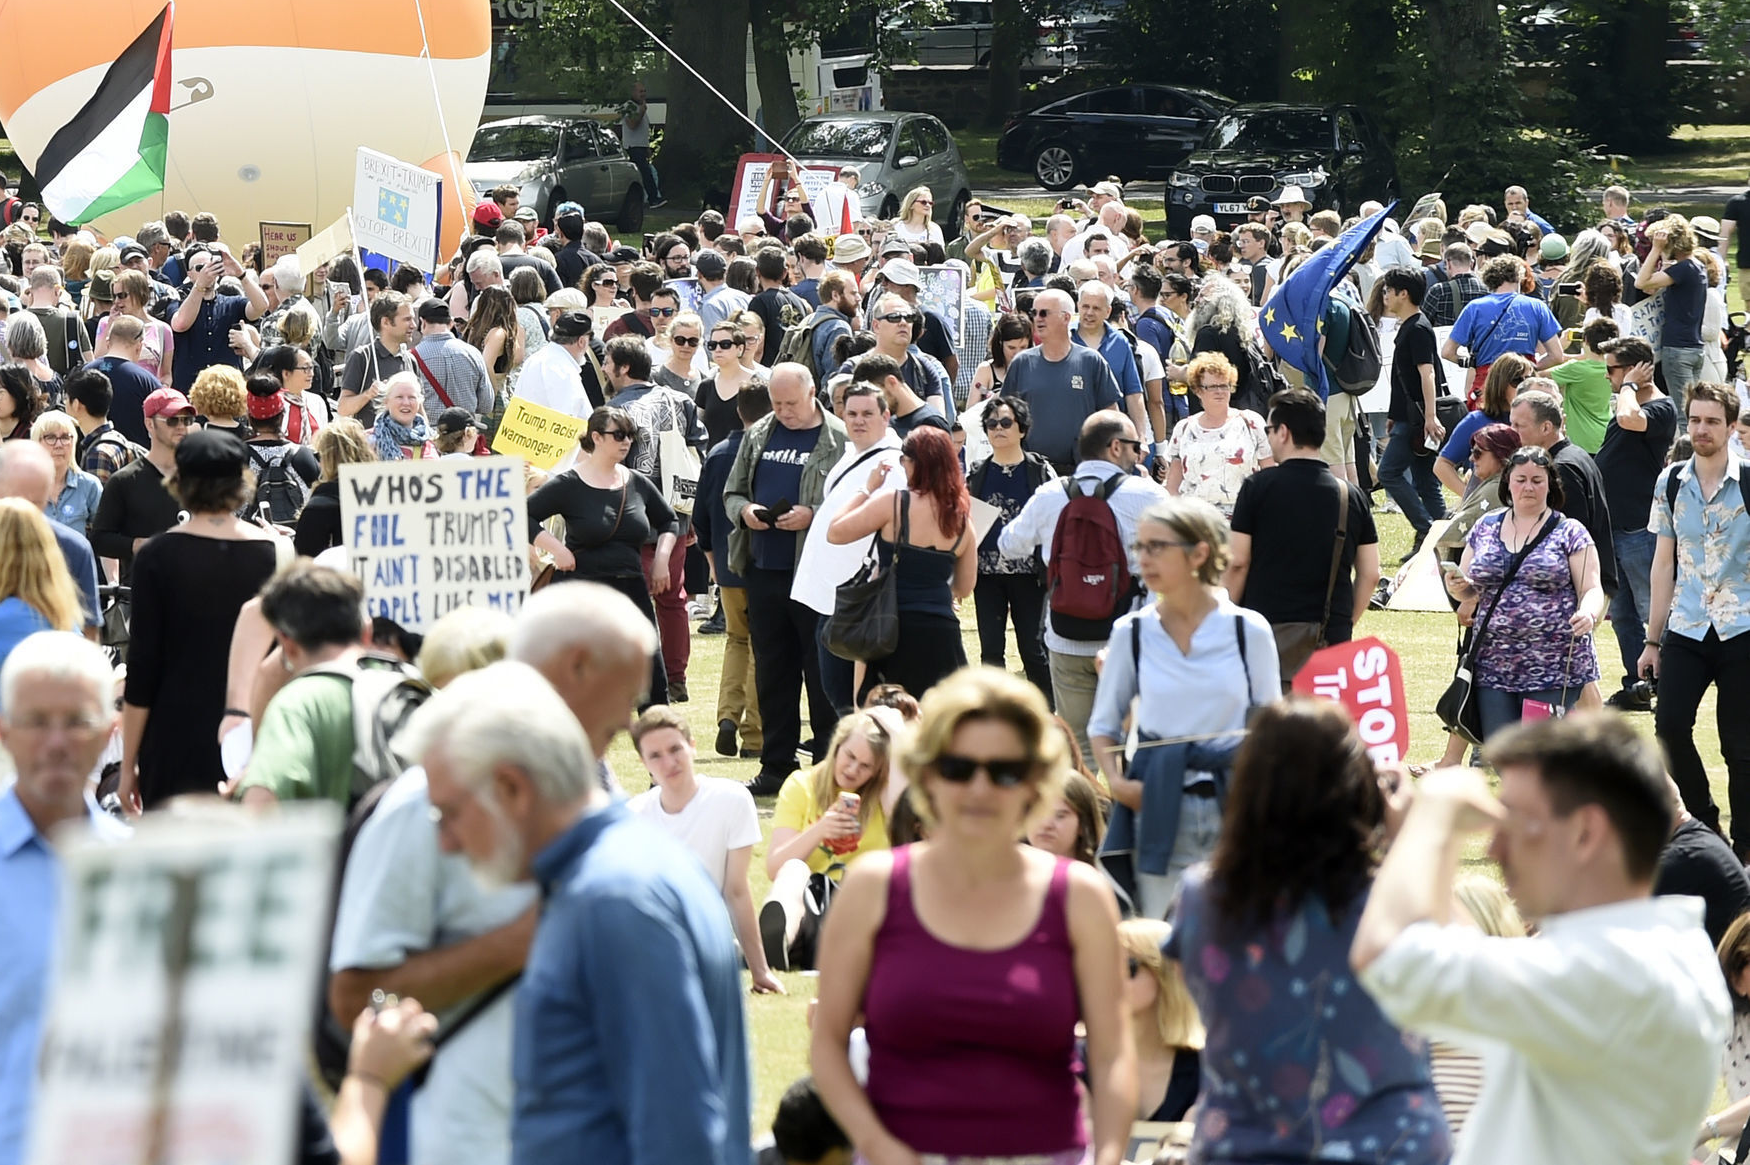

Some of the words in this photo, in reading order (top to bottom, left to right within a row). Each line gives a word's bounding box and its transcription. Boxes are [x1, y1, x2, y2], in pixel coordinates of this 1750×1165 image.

[264, 226, 284, 242] HEAR
[287, 232, 297, 242] US
[516, 405, 547, 433] Trump,
[550, 421, 579, 440] racist
[501, 424, 555, 458] warmonger,
[457, 467, 511, 500] THE
[425, 507, 514, 551] TRUMP?
[374, 555, 420, 587] AIN'T
[433, 555, 523, 584] DISABLED
[367, 591, 421, 624] EOPLE
[1353, 646, 1401, 768] STOP
